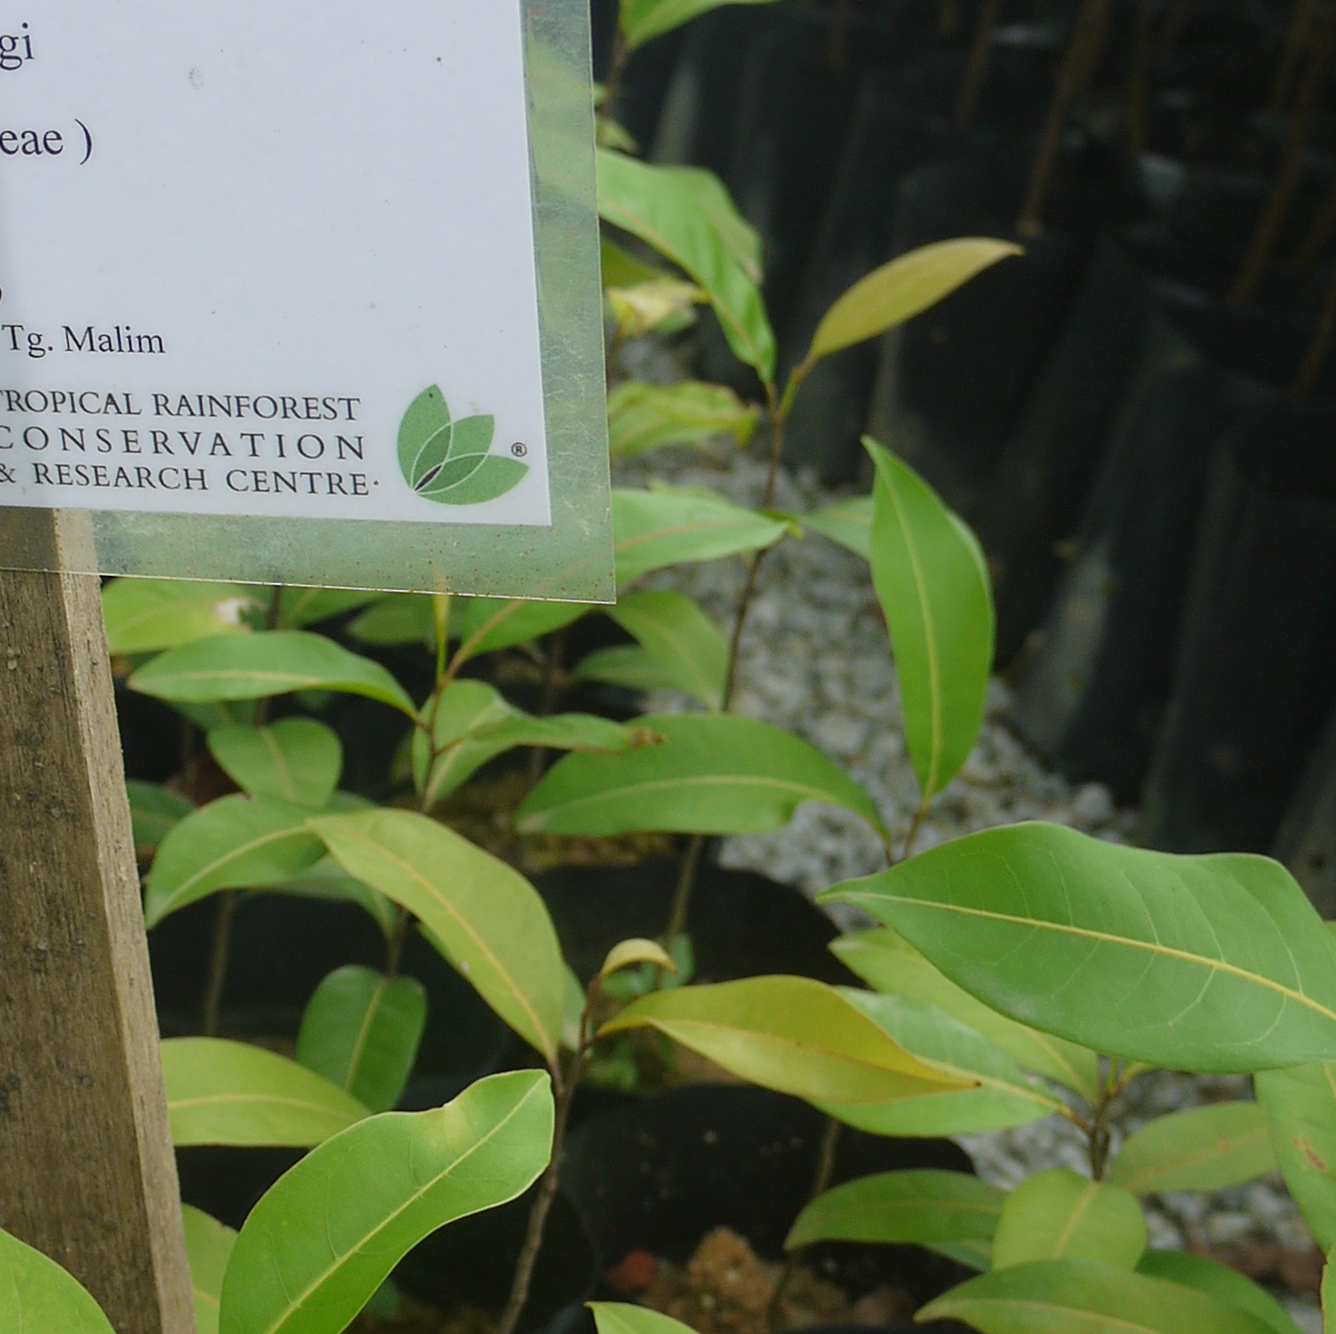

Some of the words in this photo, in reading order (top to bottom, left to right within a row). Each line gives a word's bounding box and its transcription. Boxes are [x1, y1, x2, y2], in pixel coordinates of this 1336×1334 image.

[1, 323, 55, 359] Tg.
[61, 325, 167, 354] Malim
[151, 393, 361, 421] RAINFOREST
[31, 462, 210, 491] RESEARCH
[225, 468, 370, 497] CENTRE
